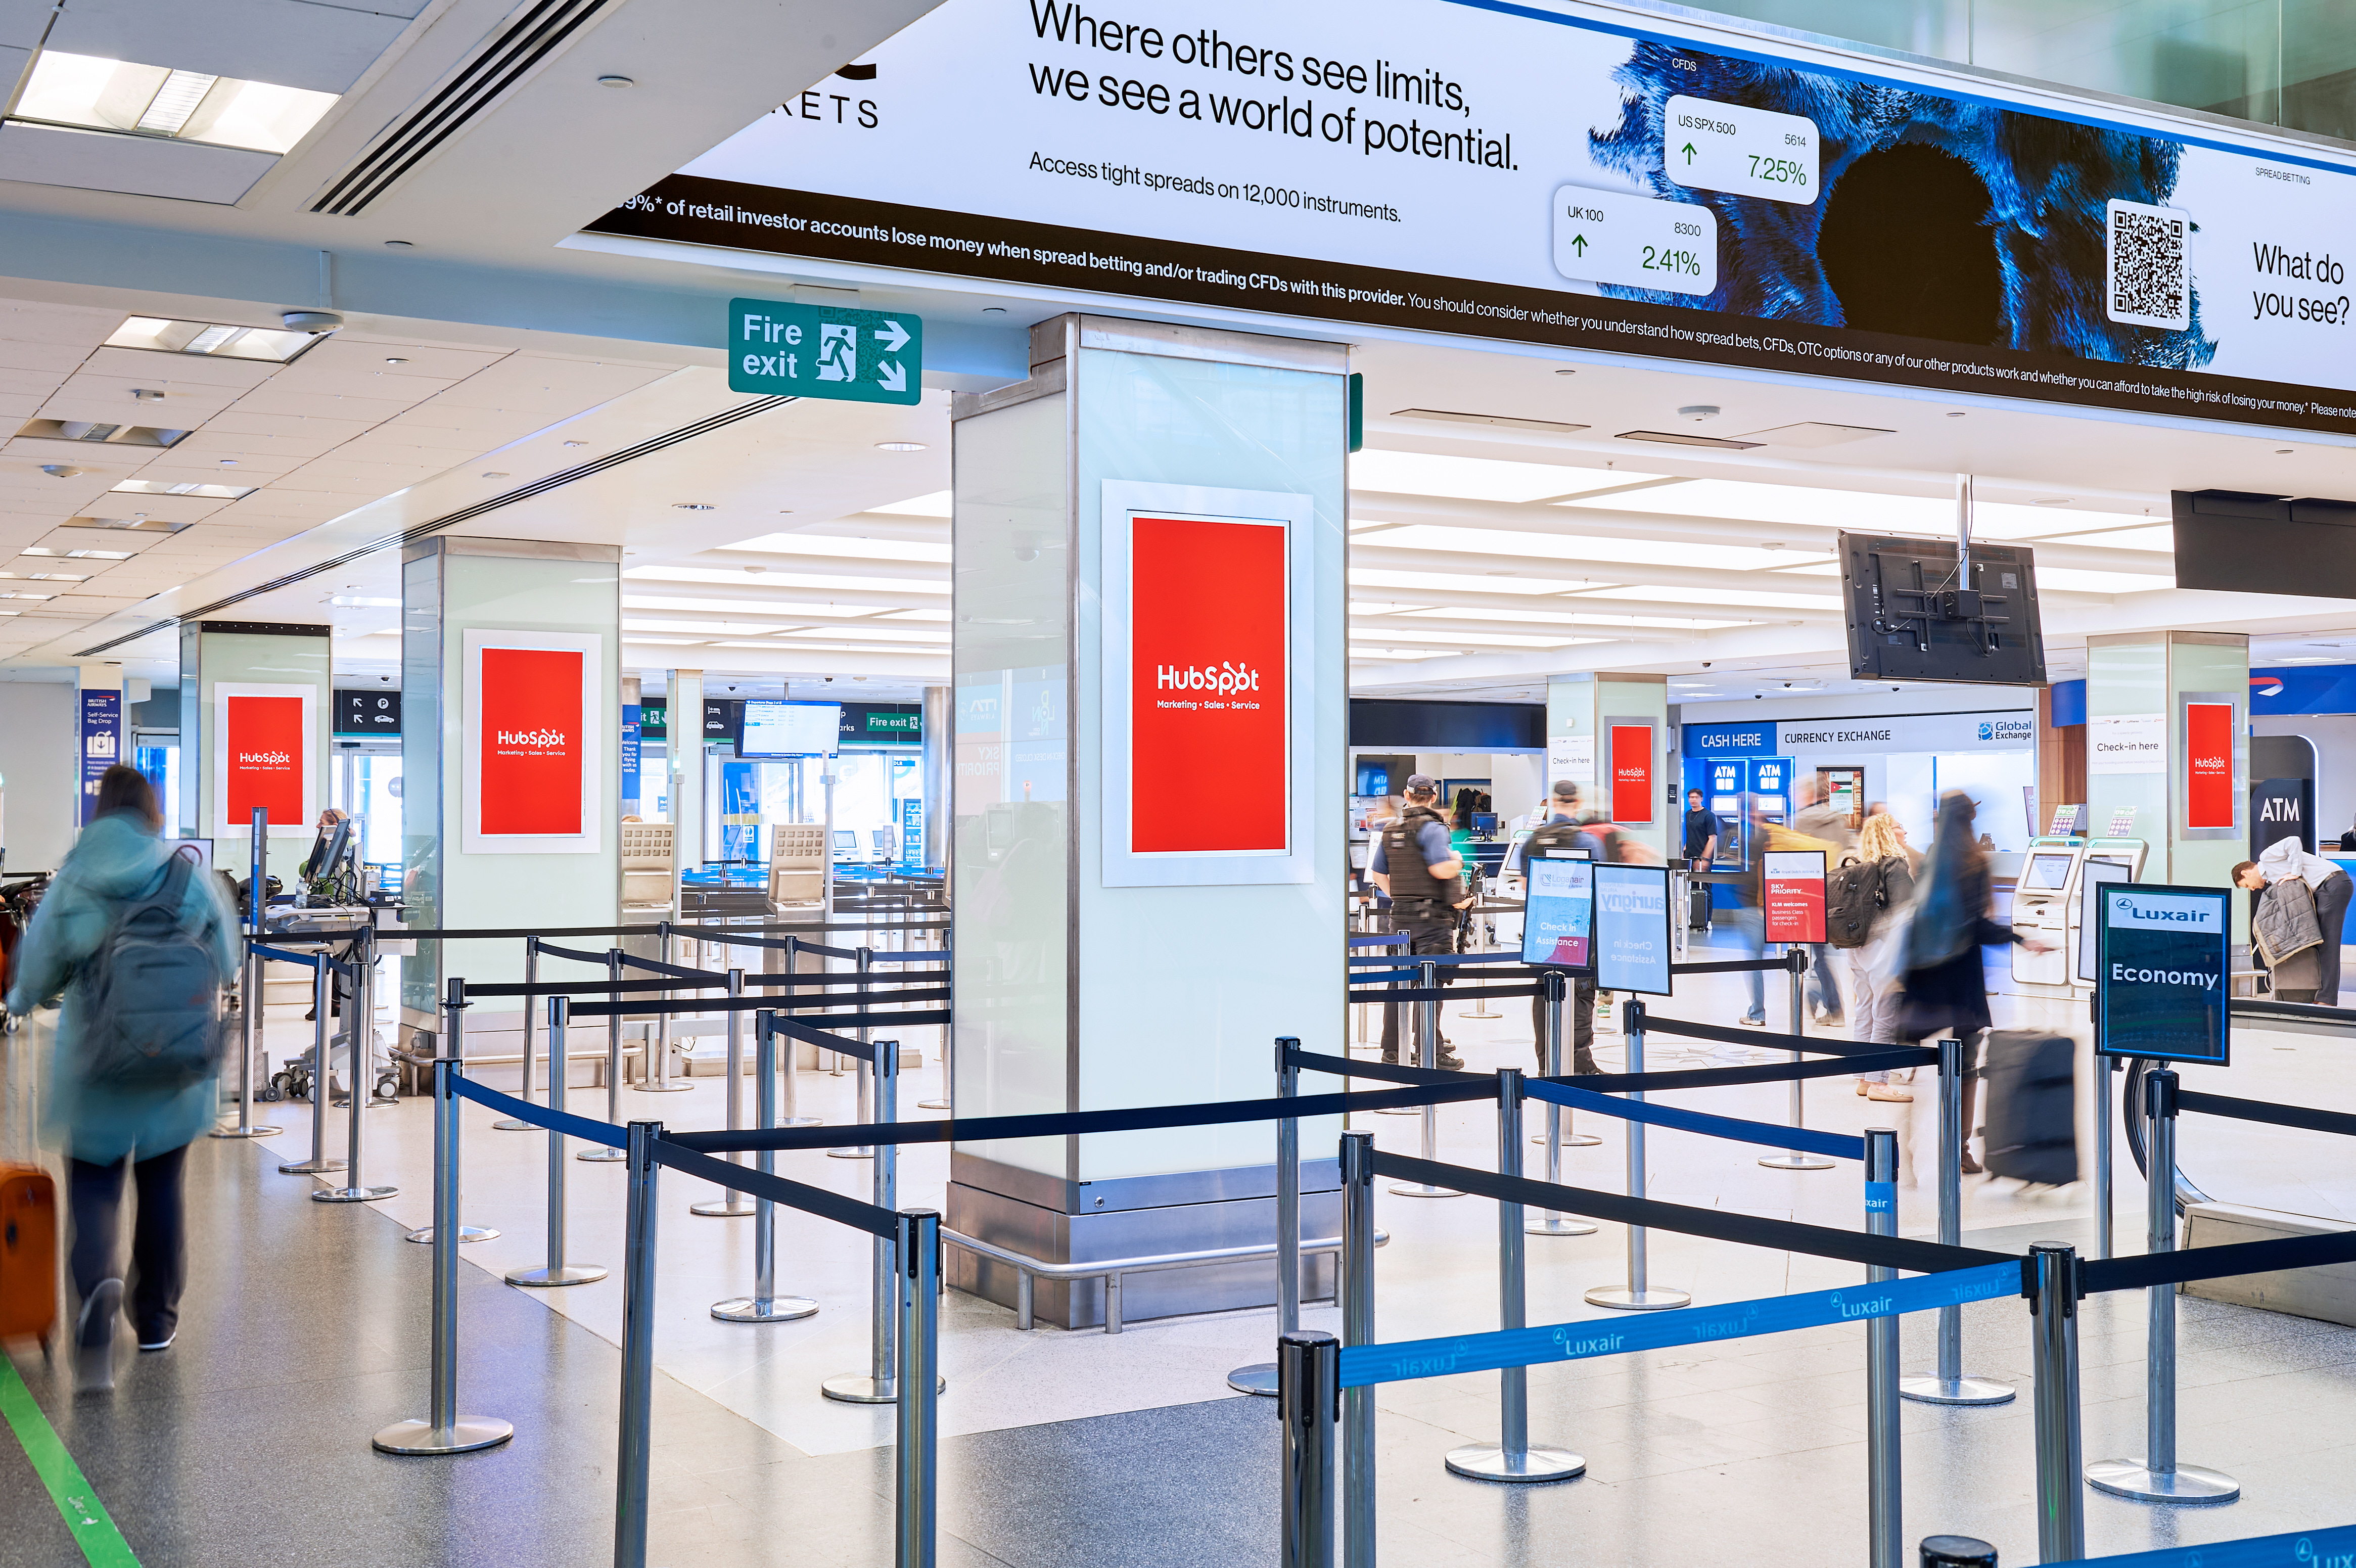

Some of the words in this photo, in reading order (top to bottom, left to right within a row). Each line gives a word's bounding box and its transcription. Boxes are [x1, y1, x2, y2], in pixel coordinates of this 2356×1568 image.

[1030, 0, 1163, 58] Where
[1173, 29, 1294, 81] others
[1302, 57, 1367, 94] see
[1377, 60, 1469, 117] limits,
[1673, 58, 1696, 71] CFDS
[1029, 63, 1089, 101] we
[1099, 76, 1170, 114] see
[1179, 90, 1202, 120] a
[1209, 94, 1311, 137] world
[1322, 107, 1355, 144] of
[1365, 119, 1517, 170] potential.
[1679, 115, 1692, 127] US
[1695, 118, 1714, 131] SPX
[1717, 122, 1735, 135] 500
[1785, 134, 1806, 147] 5614
[1749, 155, 1806, 185] 7.25%
[2256, 167, 2281, 179] SPREAD
[2283, 172, 2310, 185] BETTING
[1030, 152, 1097, 178] Access
[1101, 163, 1140, 186] tight
[1144, 173, 1214, 195] spreads
[1218, 184, 1238, 199] on
[1243, 184, 1299, 207] 12,000
[1304, 192, 1400, 222] instruments.
[1568, 206, 1583, 219] UK
[1586, 209, 1603, 221] 100
[1675, 222, 1700, 236] 8300
[1643, 246, 1700, 275] 2.41%
[2254, 242, 2311, 280] What
[2317, 254, 2343, 284] do
[667, 200, 685, 215] of
[689, 204, 733, 221] retail
[737, 207, 807, 230] investor
[811, 221, 889, 241] accounts
[893, 227, 926, 246] lose
[930, 236, 984, 256] money
[988, 241, 1030, 259] when
[1034, 248, 1086, 268] spread
[1090, 253, 1142, 276] betting
[1145, 263, 1193, 280] and/or
[1196, 267, 1246, 289] trading
[1249, 273, 1287, 291] CFDs
[1290, 280, 1318, 295] with
[1321, 283, 1346, 298] this
[1349, 288, 1405, 307] provider.
[1408, 293, 1430, 309] You
[1434, 297, 1473, 314] should
[1477, 305, 1529, 320] consider
[1531, 309, 1579, 327] whether
[1582, 318, 1602, 330] you
[1605, 320, 1668, 338] understand
[1671, 326, 1694, 340] how
[1696, 332, 1733, 345] spread
[1736, 334, 1761, 351] bets,
[1764, 338, 1795, 355] CFDs,
[1798, 342, 1822, 356] OTC
[1824, 347, 1861, 361] options
[1863, 353, 1874, 362] or
[1876, 354, 1893, 367] any
[1895, 354, 1905, 366] of
[1907, 358, 1923, 368] our
[1925, 358, 1950, 371] other
[1952, 362, 1994, 377] products
[1996, 367, 2019, 379] work
[2021, 370, 2038, 382] and
[2040, 372, 2076, 387] whether
[2078, 378, 2094, 389] you
[2097, 381, 2112, 390] can
[2114, 380, 2139, 393] afford
[2141, 383, 2150, 394] to
[2152, 385, 2169, 398] take
[2172, 387, 2185, 398] the
[2187, 388, 2204, 402] high
[2206, 391, 2221, 403] risk
[2223, 393, 2231, 404] of
[2232, 394, 2255, 409] losing
[2257, 399, 2275, 410] your
[2312, 403, 2337, 417] Please
[2253, 291, 2292, 319] you
[2298, 296, 2349, 325] see?
[745, 314, 802, 345] Fire
[744, 351, 797, 378] exit
[1158, 661, 1259, 696] HubSpot
[1158, 700, 1197, 710] Marketing
[1204, 701, 1224, 709] Sales
[1231, 701, 1260, 709] Service
[870, 718, 887, 726] Fire
[890, 718, 906, 726] exit
[1996, 720, 2031, 730] Global
[498, 728, 565, 748] HubSpot
[1702, 735, 1729, 747] CASH
[1733, 733, 1761, 746] HERE
[1785, 732, 1834, 743] CURRENCY
[1838, 730, 1890, 741] EXCHANGE
[1996, 728, 2031, 740] Exchange
[2098, 743, 2136, 751] Check-in
[240, 751, 290, 764] HubSpot
[2195, 756, 2225, 769] HubSpot
[1619, 767, 1644, 777] HubSpot
[1715, 766, 1735, 777] ATM
[1759, 765, 1780, 776] ATM
[2260, 798, 2299, 821] ATM
[1552, 874, 1584, 884] Loganair
[2133, 908, 2209, 922] Luxair
[1540, 922, 1567, 932] Check
[1569, 924, 1576, 932] in
[1536, 936, 1578, 947] Assistance
[2113, 963, 2218, 990] Economy
[1842, 1297, 1892, 1320] Luxair
[1566, 1334, 1627, 1358] Luxair
